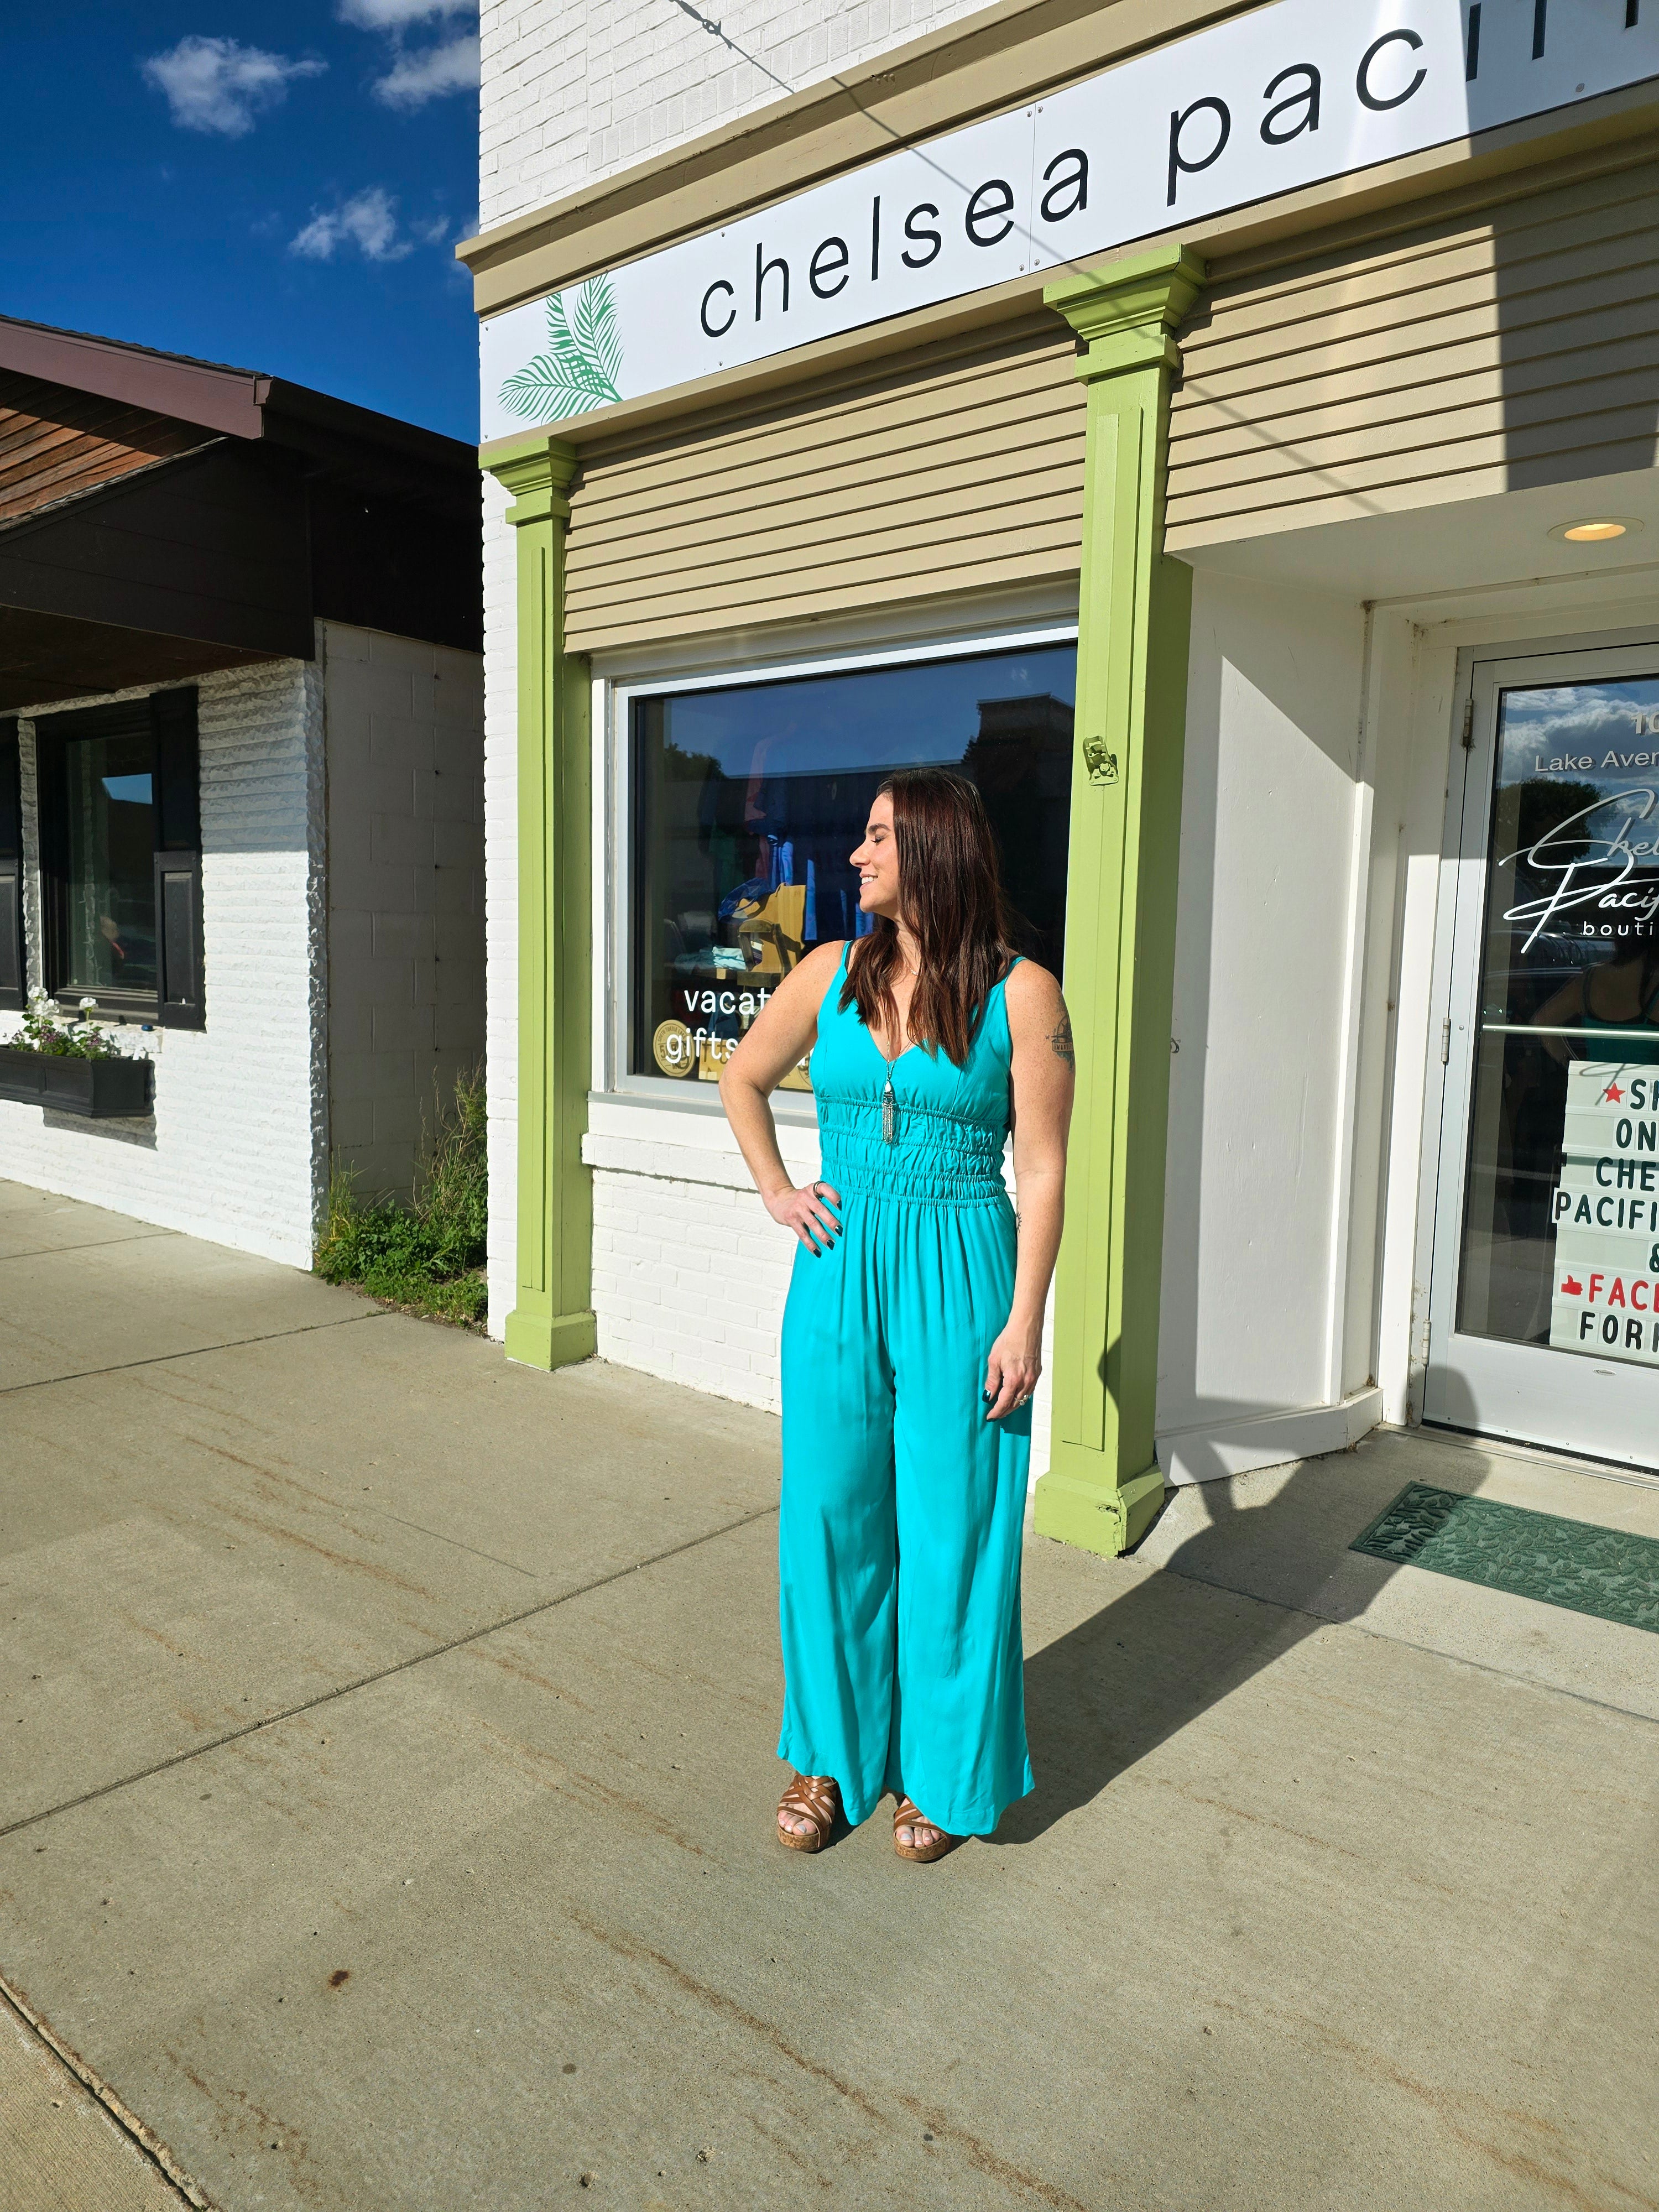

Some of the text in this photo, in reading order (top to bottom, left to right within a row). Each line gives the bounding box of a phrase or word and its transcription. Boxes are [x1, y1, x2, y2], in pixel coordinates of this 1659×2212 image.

[701, 148, 1088, 338] chelsea
[1535, 753, 1593, 772] Lake
[1583, 921, 1653, 936] bouti
[684, 987, 779, 1015] vacat
[666, 1027, 739, 1064] gifts
[1616, 1118, 1656, 1151] ON
[1596, 1156, 1656, 1192] CHE
[1555, 1191, 1657, 1232] PACIFI
